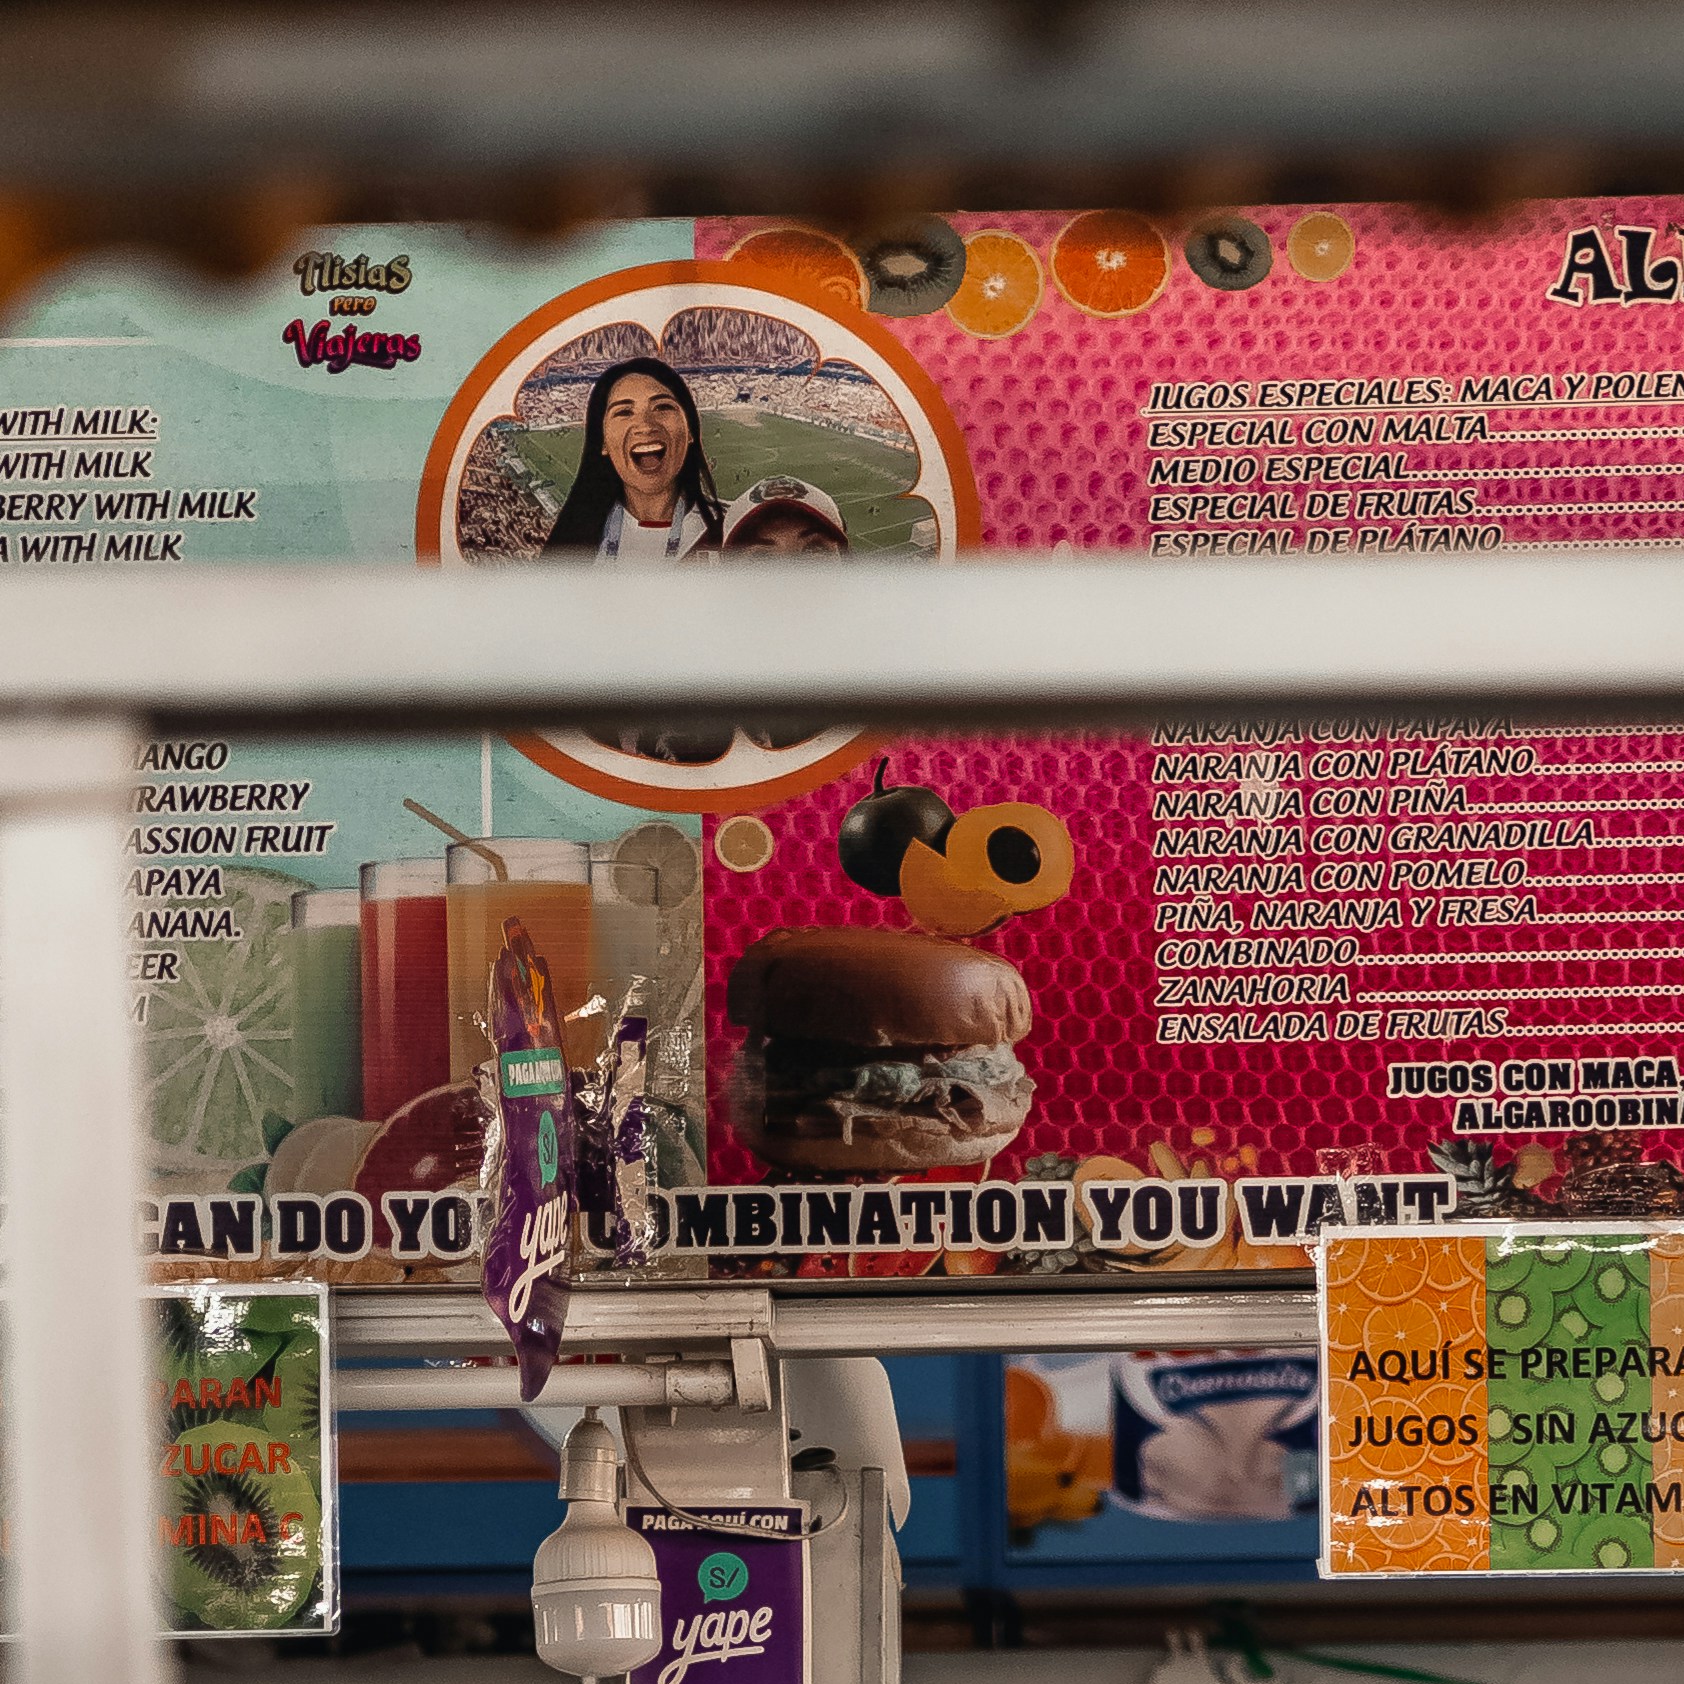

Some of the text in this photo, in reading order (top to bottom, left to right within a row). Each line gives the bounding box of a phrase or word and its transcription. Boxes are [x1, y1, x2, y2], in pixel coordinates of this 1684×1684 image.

[282, 319, 421, 374] Viajeras
[1258, 380, 1451, 409] ESPECIALES:
[1460, 377, 1553, 403] MACA
[1566, 375, 1585, 400] Y
[72, 409, 158, 439] MILK:
[1150, 415, 1487, 447] ESPECIAL CON MALTA
[73, 451, 152, 479] MILK
[1150, 454, 1410, 484] MEDIO ESPECIAL
[94, 490, 256, 522] WITH MILK
[1151, 489, 1480, 521] ESPECIAL DE FRUTAS
[20, 532, 97, 564] WITH
[104, 534, 182, 562] MILK
[1150, 522, 1503, 556] ESPECIAL DE PLÁTANO
[1154, 744, 1537, 782] NARANJA CON PLÁTANO
[1155, 781, 1466, 819] NARANJA CON PIÑA
[244, 824, 334, 854] FRUIT
[1155, 821, 1593, 858] NARANJA CON GRANADILLA
[1156, 860, 1528, 895] NARANJA CON POMELO
[1157, 897, 1536, 932] PIÑA, NARANJA Y FRESA
[1157, 939, 1357, 967] COMBINADO
[1157, 975, 1348, 1004] ZANAHORIA
[1159, 1010, 1510, 1041] ENSALADA DE FRUTAS
[1390, 1064, 1493, 1095] JUGOS
[1503, 1062, 1571, 1092] CON
[279, 1198, 364, 1254] DO
[1090, 1183, 1223, 1243] YOU
[509, 1190, 568, 1324] yape
[1349, 1342, 1450, 1386] AQUÍ
[1464, 1348, 1507, 1380] SE
[1349, 1413, 1478, 1447] JUGOS
[1513, 1412, 1575, 1445] SIN
[1350, 1485, 1475, 1518] ALTOS
[1490, 1483, 1539, 1515] EN
[750, 1514, 790, 1531] CON
